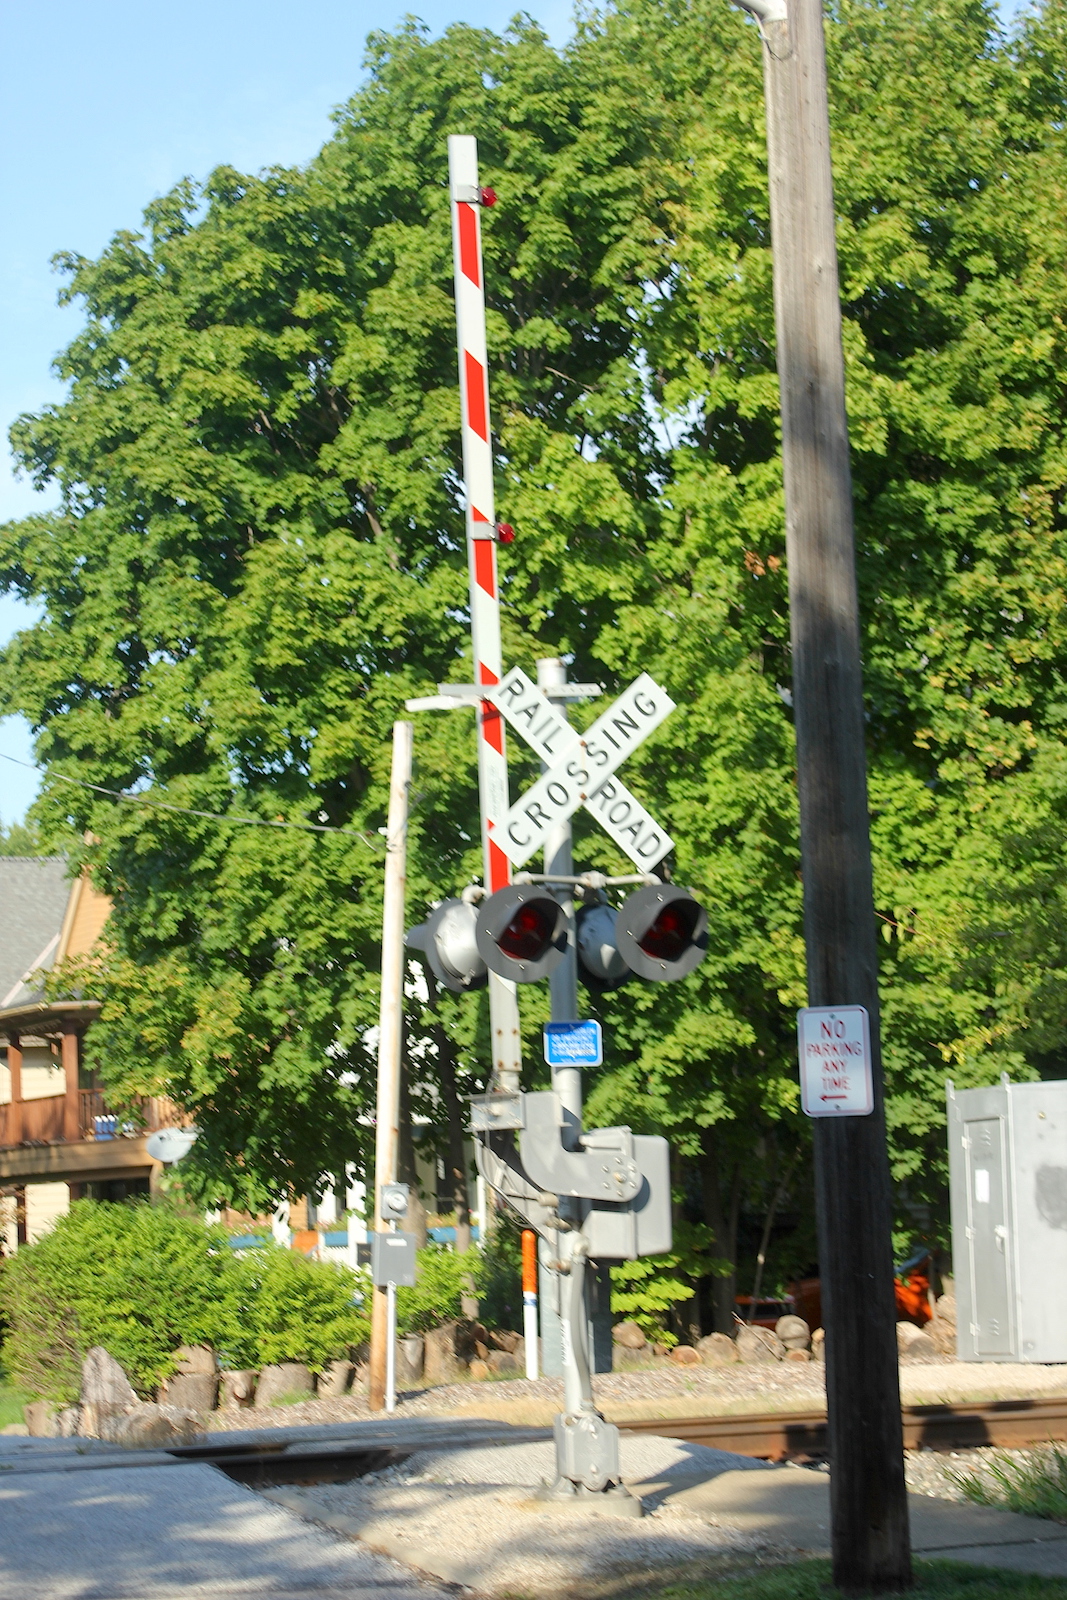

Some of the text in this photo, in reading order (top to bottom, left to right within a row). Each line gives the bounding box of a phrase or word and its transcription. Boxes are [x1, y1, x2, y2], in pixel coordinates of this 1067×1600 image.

[498, 678, 662, 858] RAIL ROAD
[508, 692, 658, 847] CROSSING
[820, 1019, 846, 1039] NO
[806, 1041, 863, 1058] PARKING
[822, 1059, 848, 1074] ANY
[821, 1076, 851, 1091] TIME
